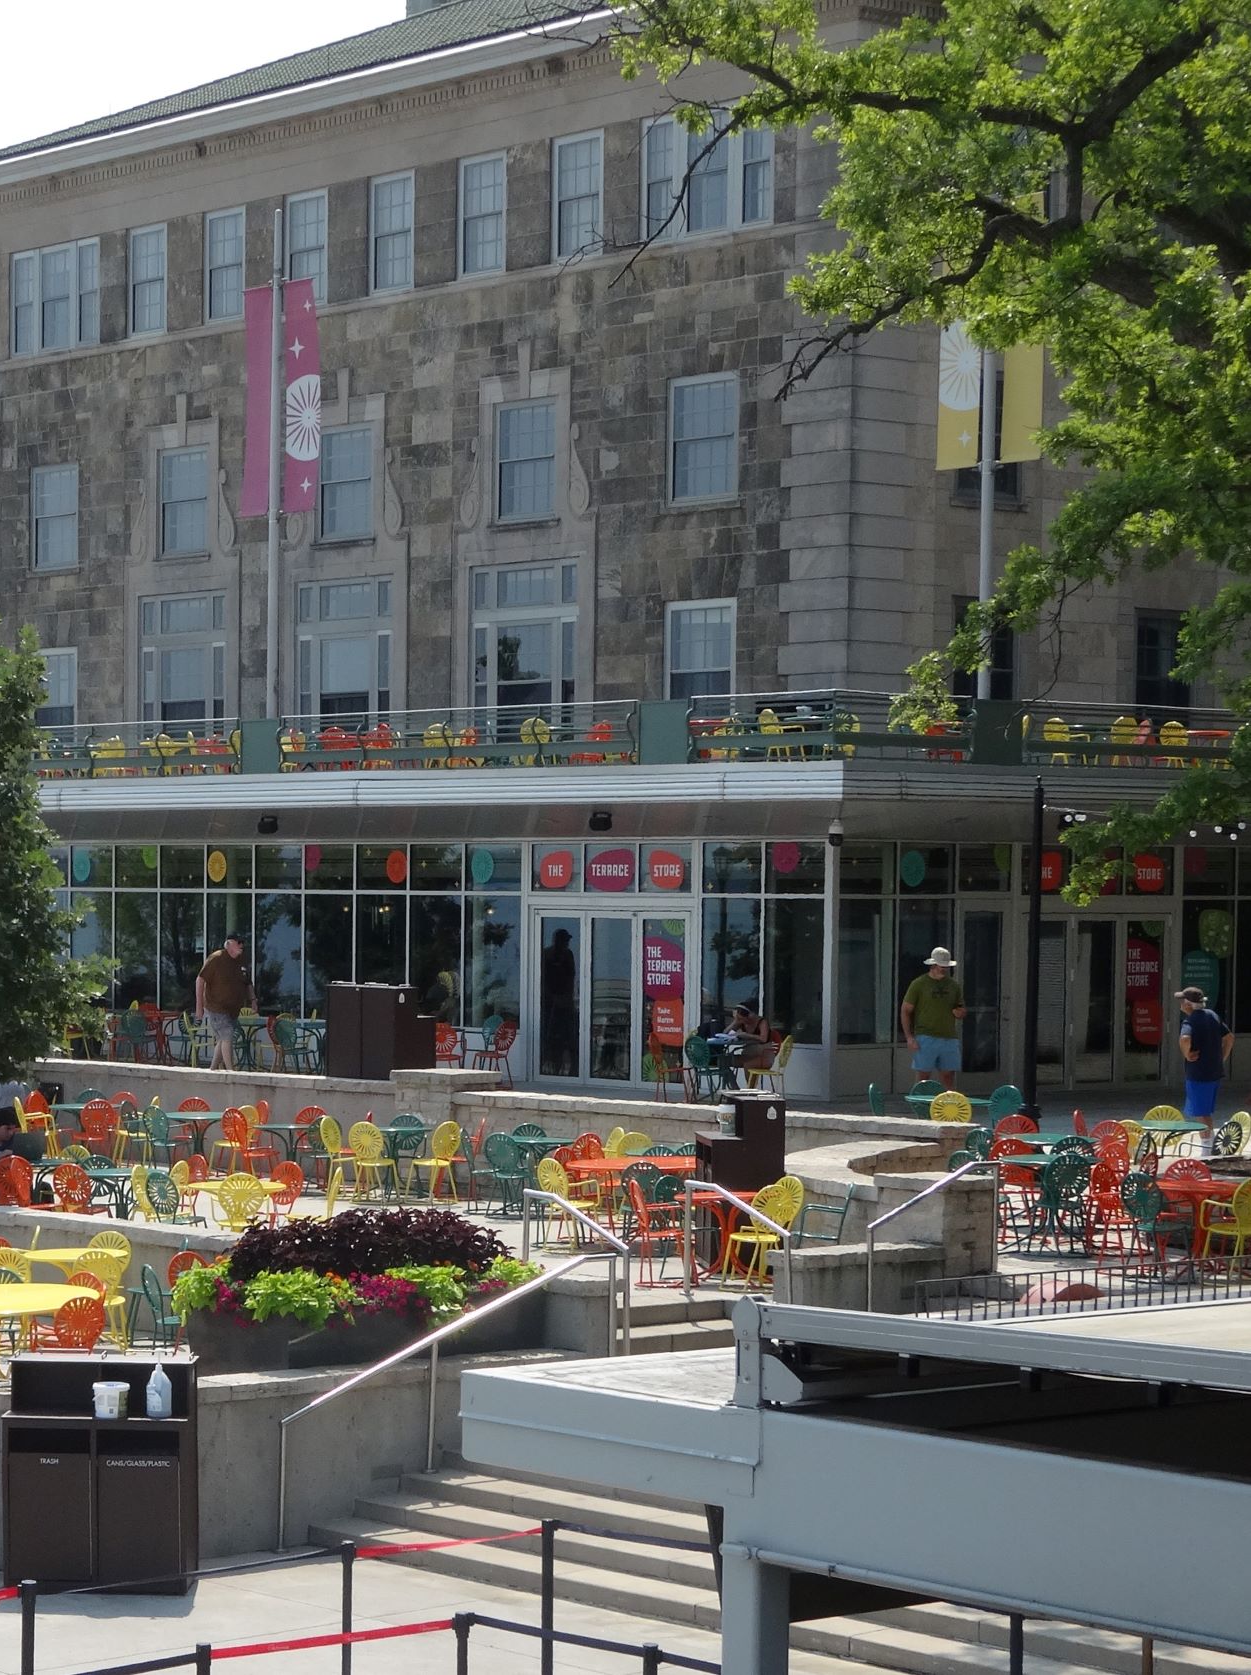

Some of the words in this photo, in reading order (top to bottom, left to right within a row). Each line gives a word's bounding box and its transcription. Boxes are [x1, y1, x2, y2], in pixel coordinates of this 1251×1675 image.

[548, 864, 563, 877] THE
[591, 864, 629, 877] TERRACE
[653, 864, 681, 878] STORE
[1041, 866, 1053, 879] HE
[1137, 868, 1161, 880] STORE
[646, 946, 662, 958] THE
[1127, 948, 1141, 960] THE
[646, 959, 682, 972] TERRACE
[1126, 961, 1159, 973] TERRACE
[646, 972, 671, 986] STORE
[1126, 975, 1149, 986] STORE
[40, 1457, 59, 1465] TRASH
[106, 1459, 171, 1467] CANS/GLASS/PLASTIC
